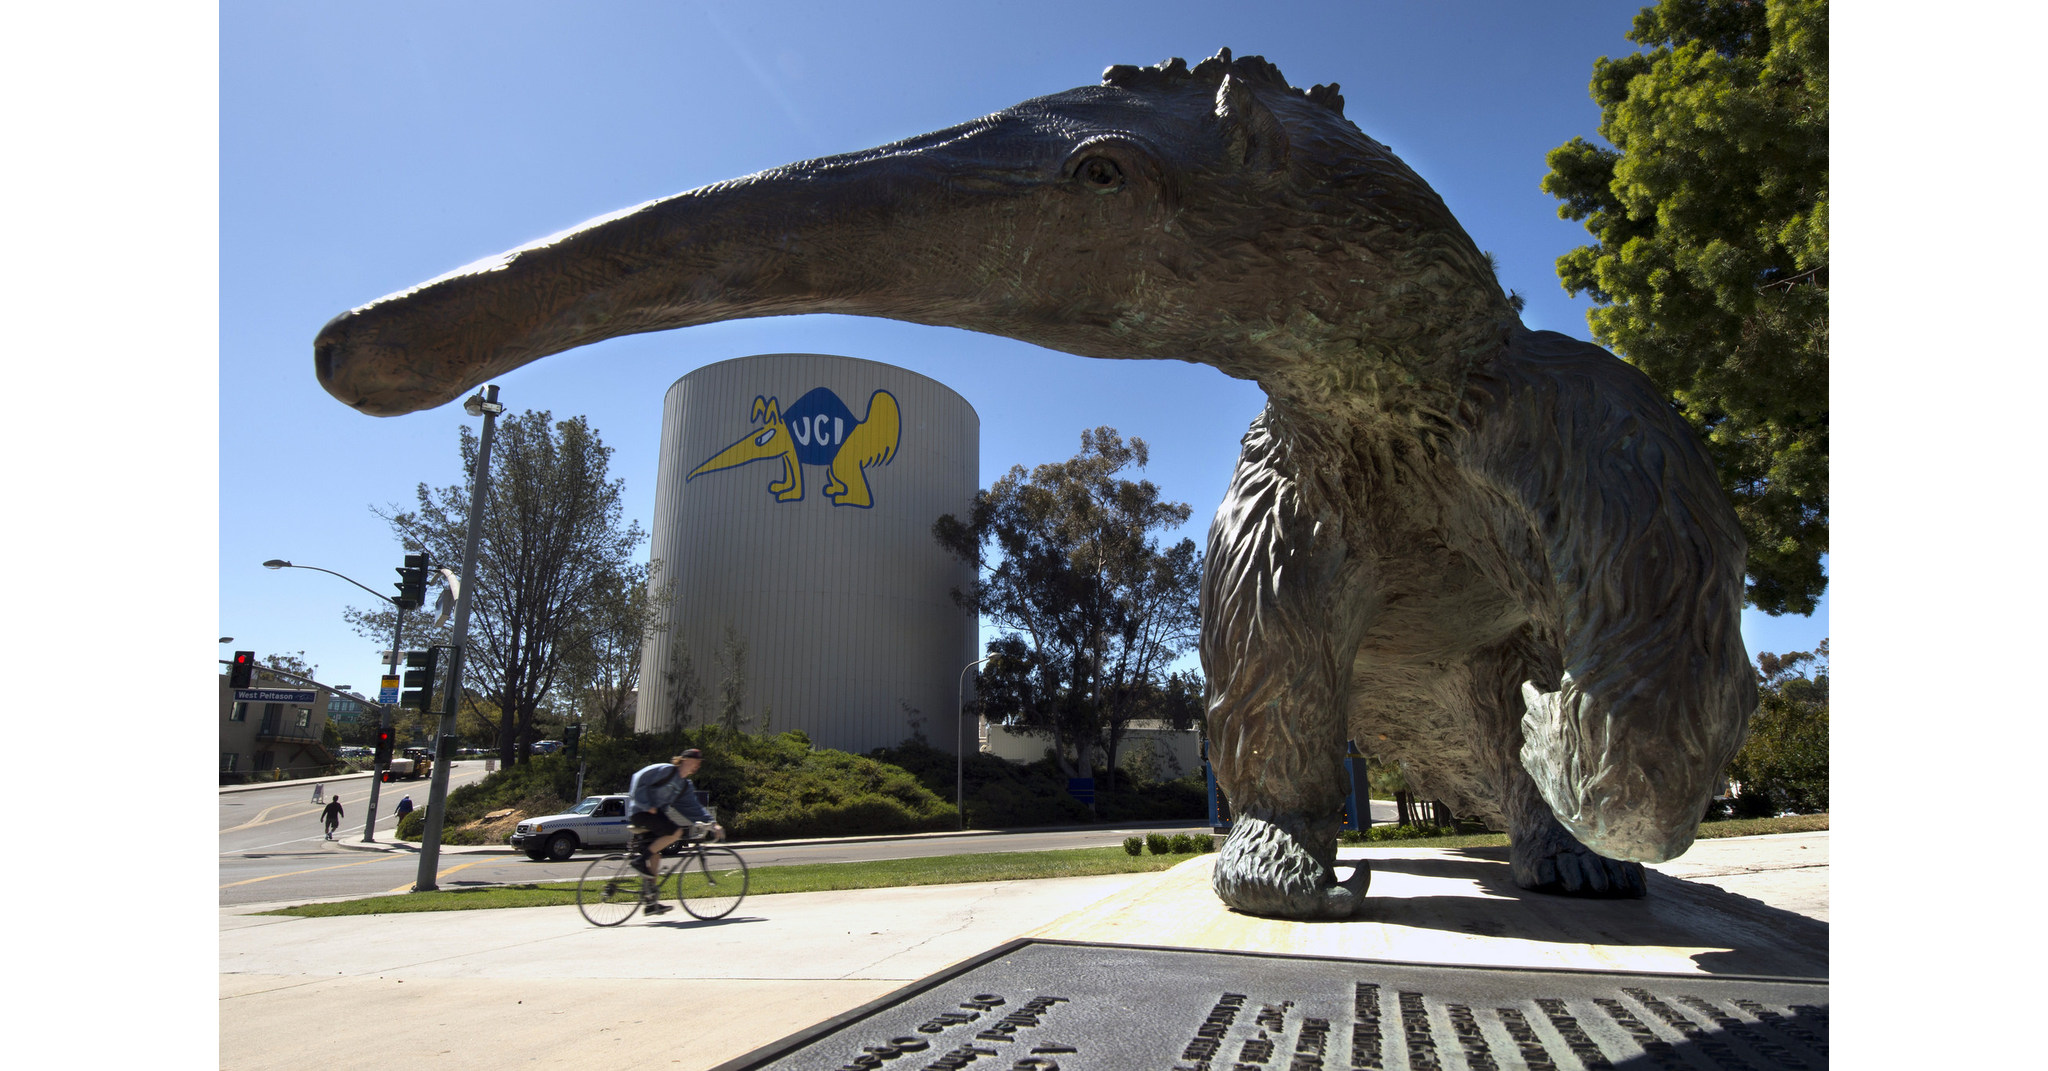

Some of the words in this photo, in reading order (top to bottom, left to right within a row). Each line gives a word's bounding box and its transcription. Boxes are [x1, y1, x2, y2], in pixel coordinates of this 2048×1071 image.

[792, 413, 844, 447] UCI
[239, 691, 258, 699] West
[259, 691, 293, 700] Peltason
[917, 1012, 981, 1033] The
